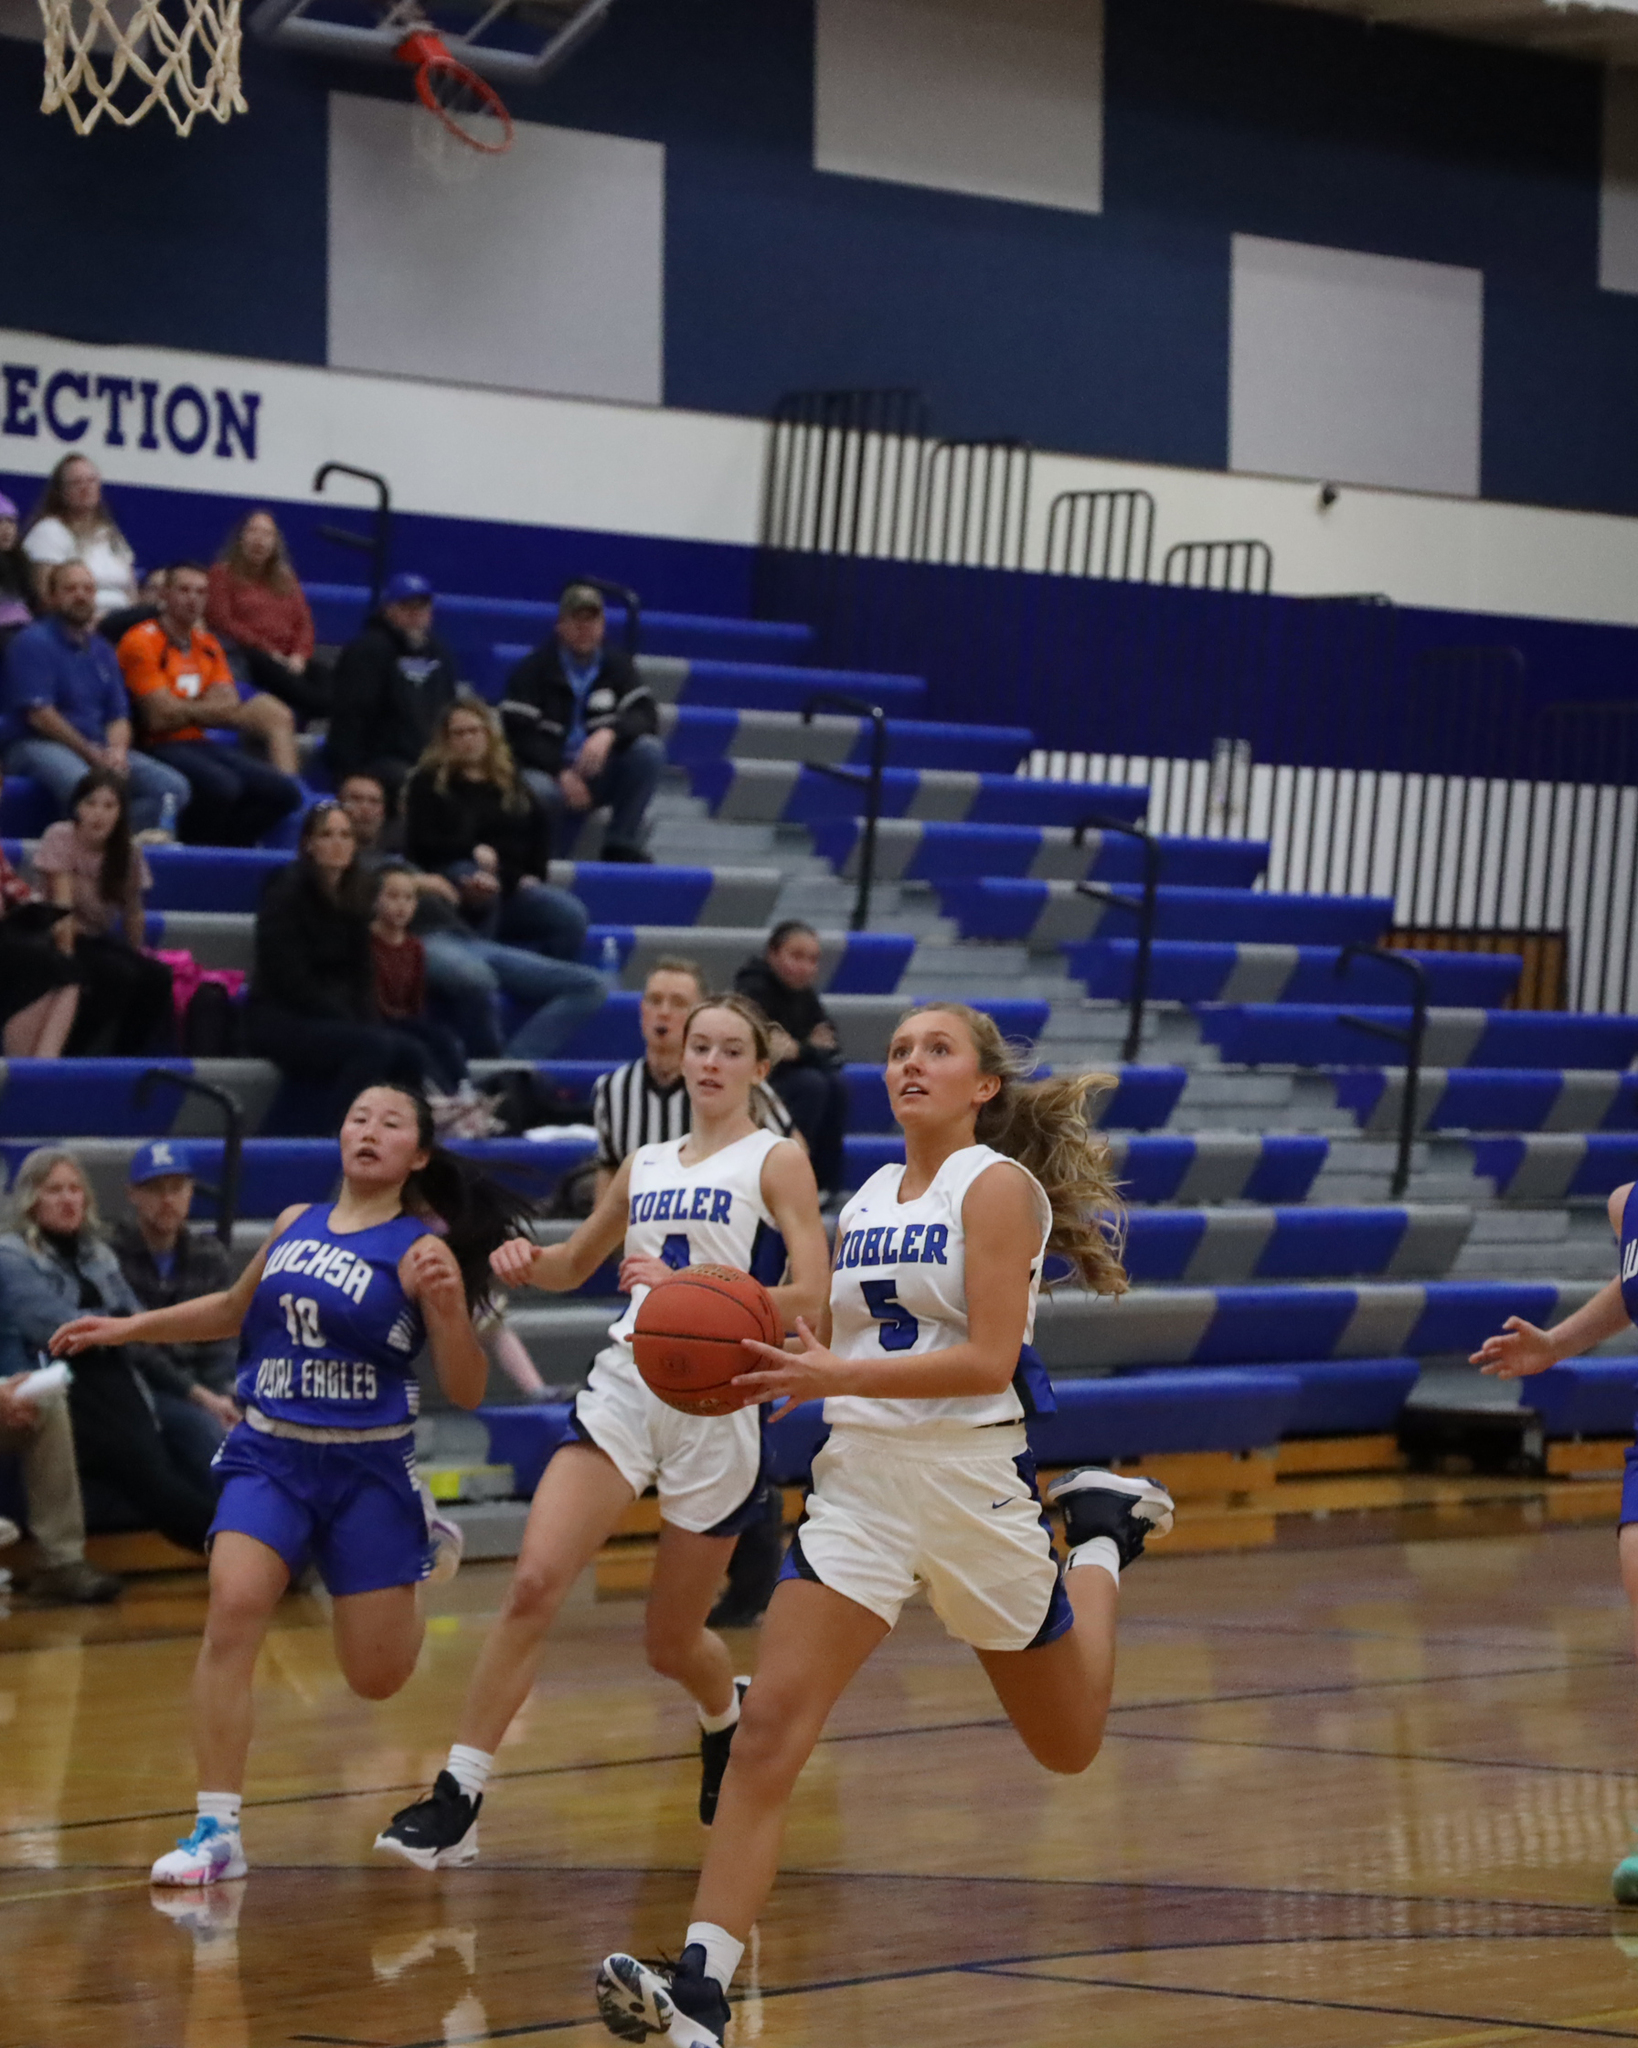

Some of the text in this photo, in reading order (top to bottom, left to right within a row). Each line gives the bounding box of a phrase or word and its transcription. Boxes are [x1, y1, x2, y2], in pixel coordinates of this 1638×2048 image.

[2, 362, 261, 461] ECTION
[261, 1239, 373, 1305] WCHSA
[279, 1293, 327, 1348] 10
[859, 1279, 919, 1352] 5
[301, 1358, 377, 1400] EAGLES
